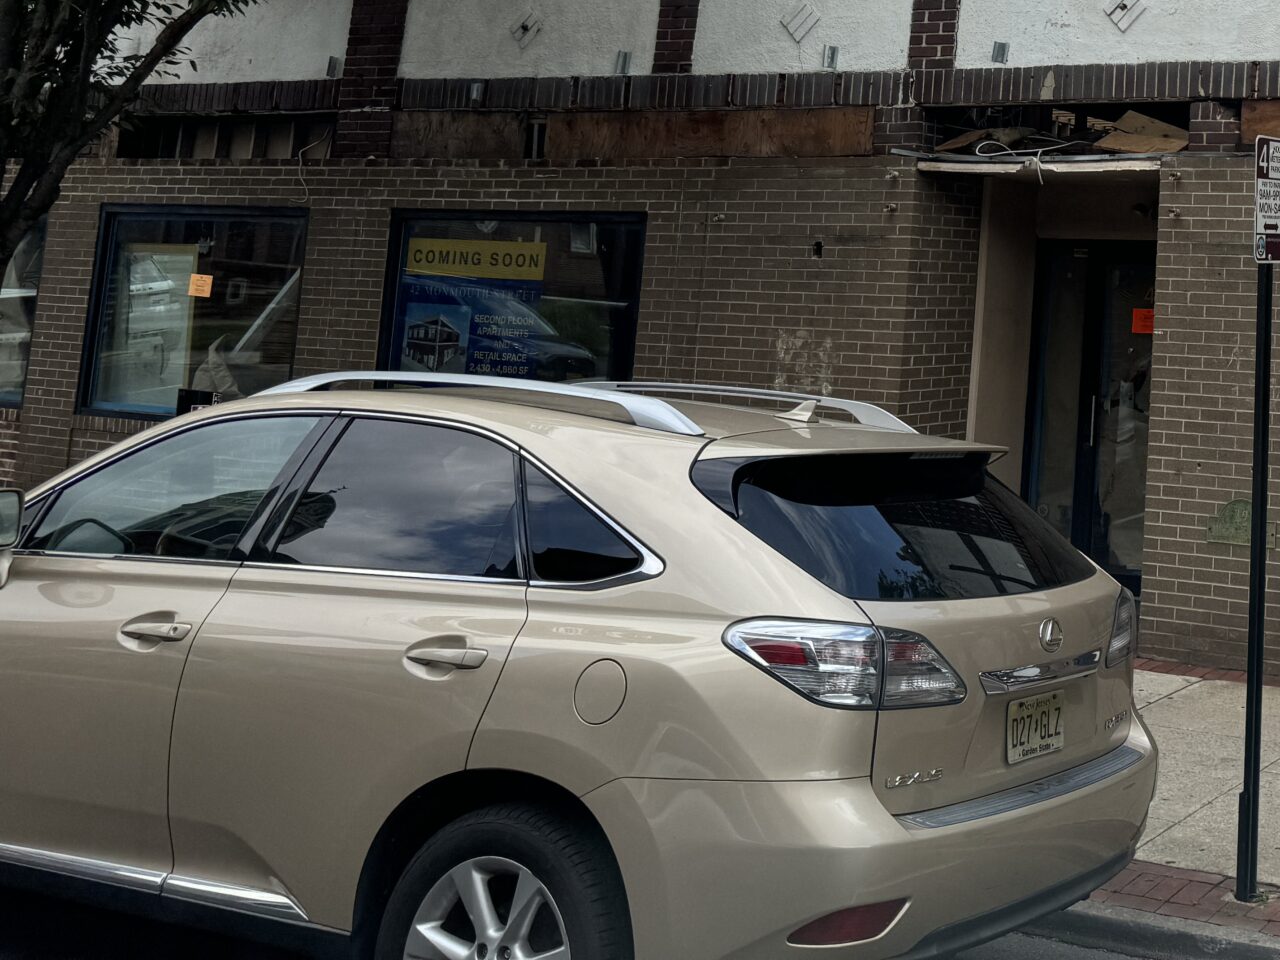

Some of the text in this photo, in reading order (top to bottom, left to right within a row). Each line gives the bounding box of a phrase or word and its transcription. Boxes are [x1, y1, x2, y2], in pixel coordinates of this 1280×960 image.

[1259, 144, 1268, 174] 4
[413, 249, 540, 268] COMING SOON
[424, 285, 489, 300] MONMOUTH
[493, 287, 536, 302] STREET
[474, 313, 535, 326] SECOND FLOOR
[477, 326, 529, 338] APARTMENTS
[494, 339, 510, 349] AND
[474, 350, 528, 362] RETAIL SPACE
